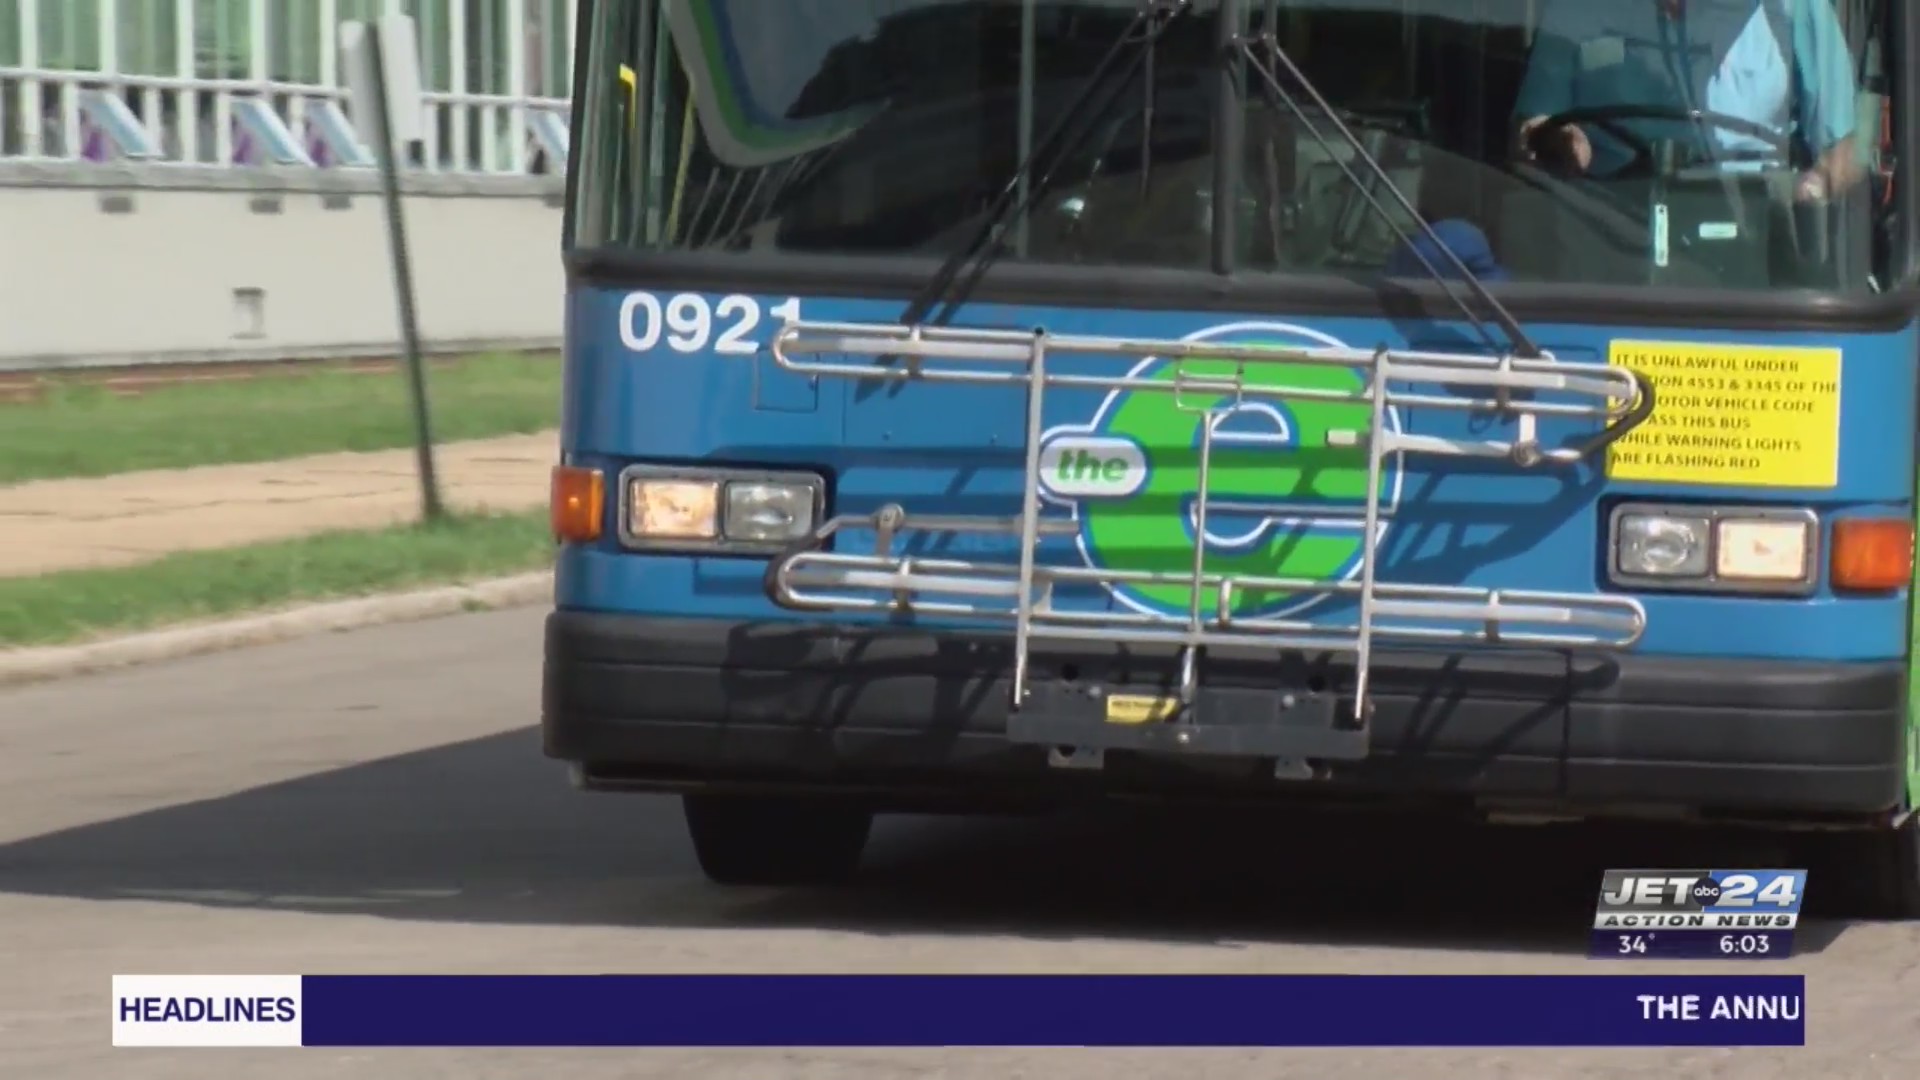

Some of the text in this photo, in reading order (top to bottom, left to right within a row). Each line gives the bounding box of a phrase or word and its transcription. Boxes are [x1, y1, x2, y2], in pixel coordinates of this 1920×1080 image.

[1616, 354, 1799, 373] IT IS UNLAWFUL UNDER
[1729, 379, 1740, 391] &
[1786, 381, 1804, 393] OF
[1657, 396, 1816, 413] OTOR VEHICLE CODE
[1682, 416, 1715, 428] THIS
[1720, 417, 1751, 430] BUS
[1666, 434, 1742, 449] WARNING
[1747, 438, 1802, 451] LIGHTS
[1057, 450, 1128, 482] the
[1612, 453, 1760, 468] ARE FLASHING RED
